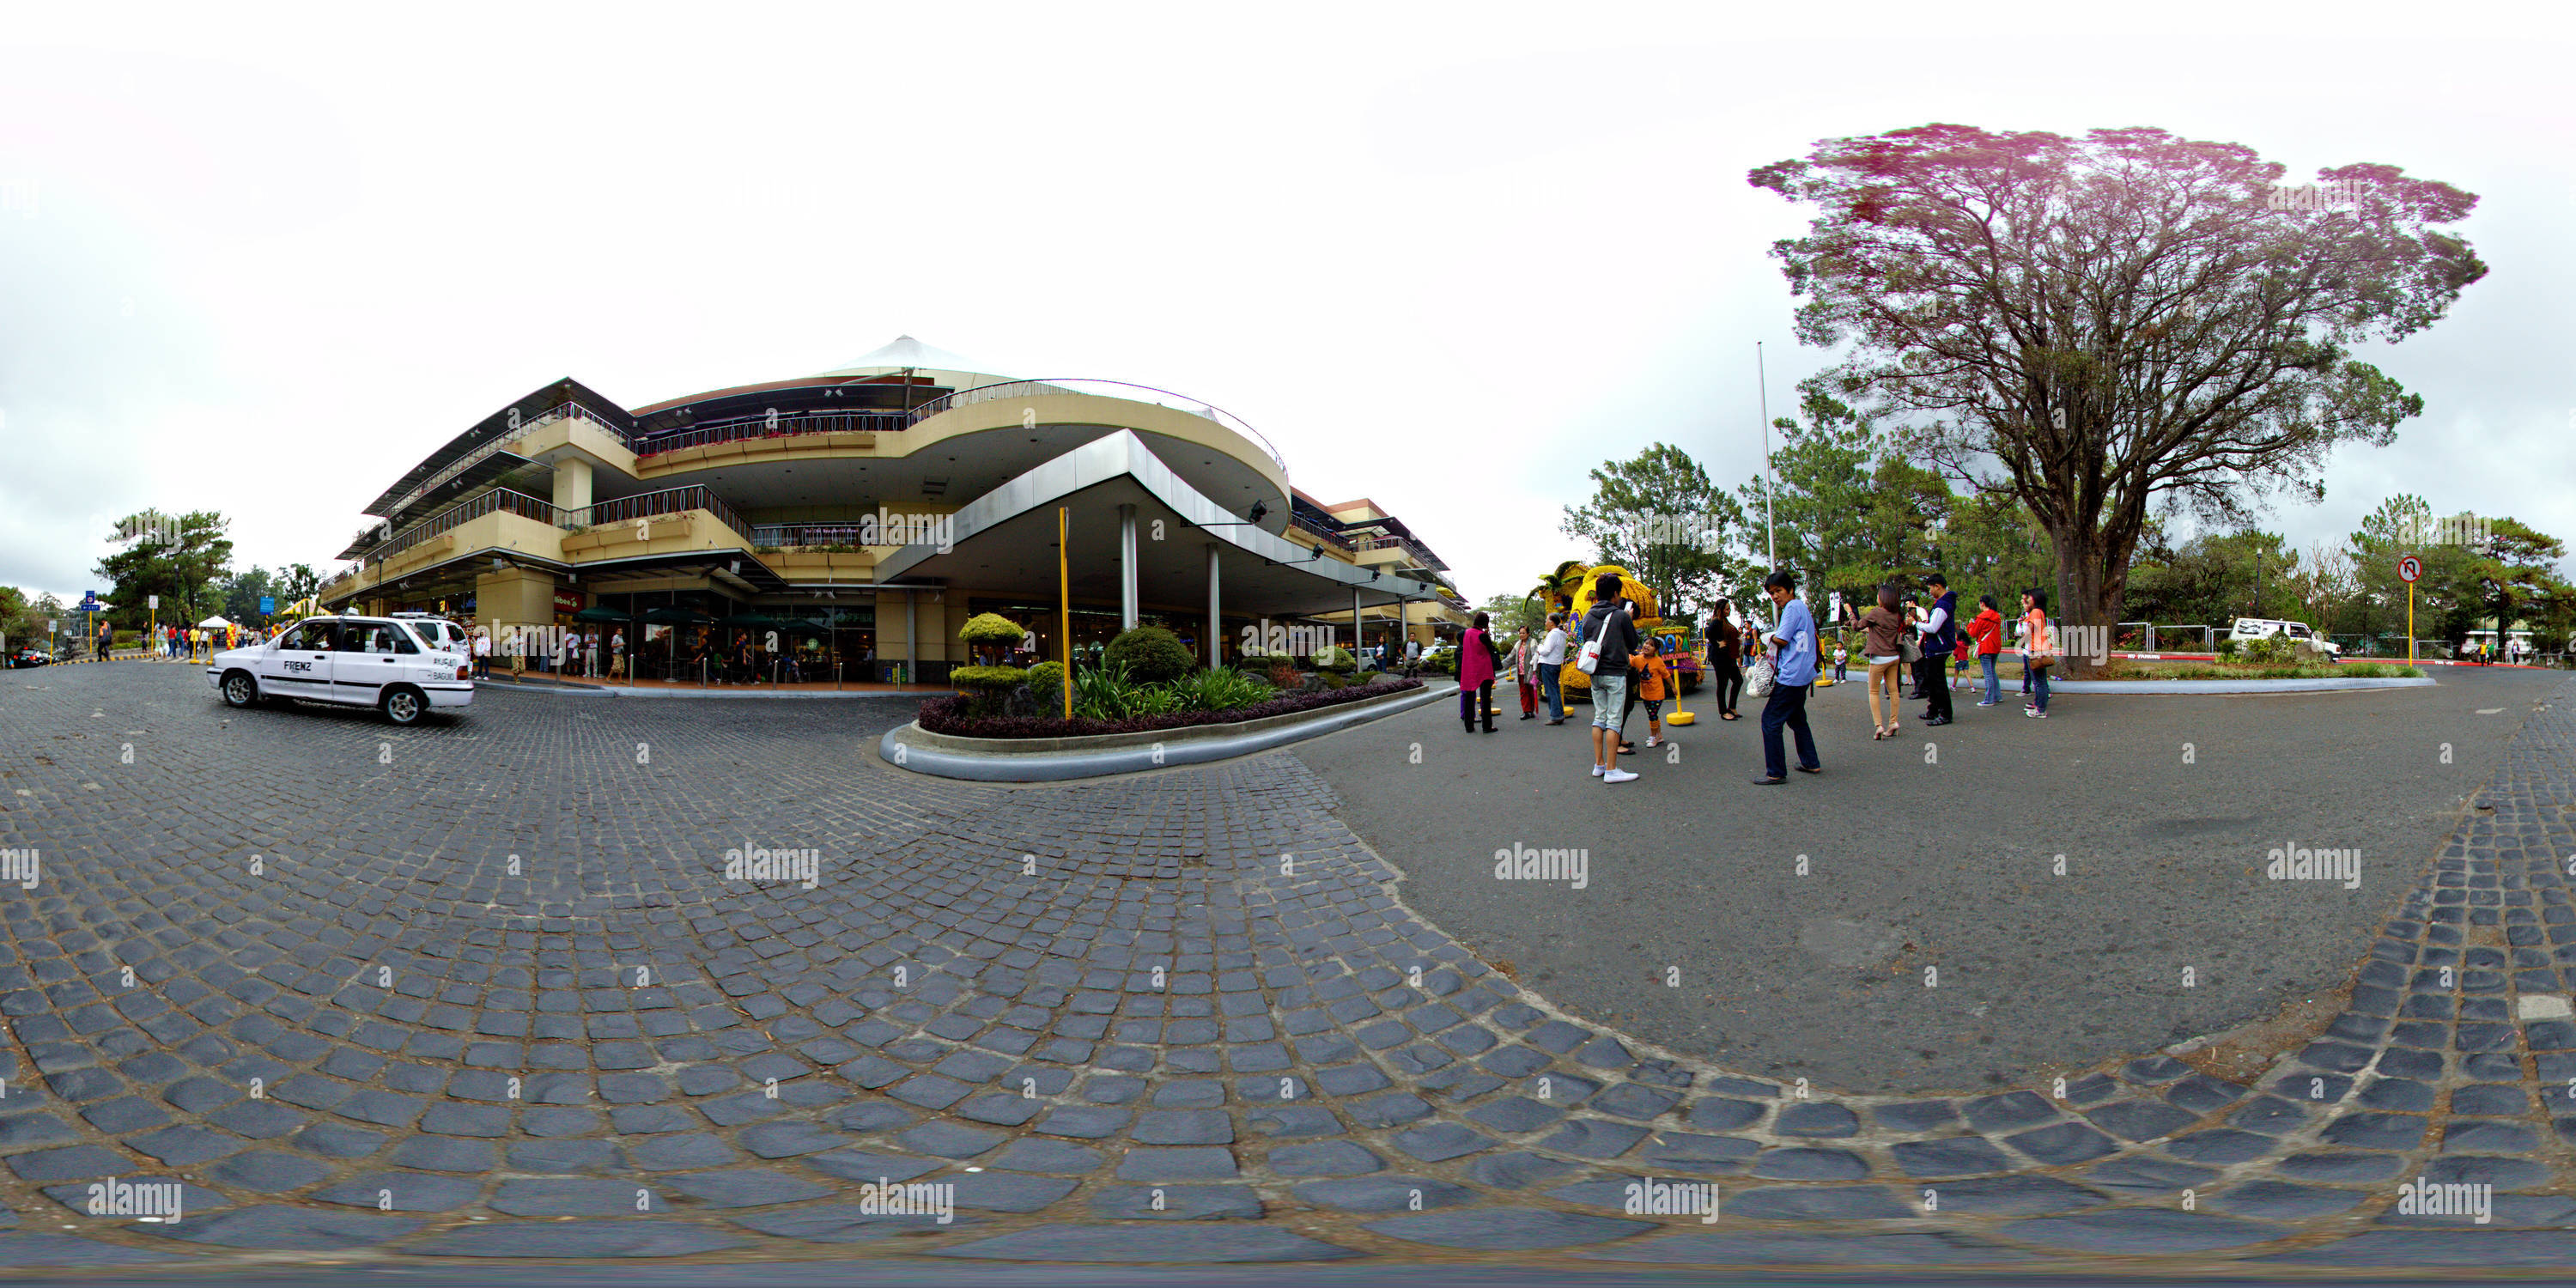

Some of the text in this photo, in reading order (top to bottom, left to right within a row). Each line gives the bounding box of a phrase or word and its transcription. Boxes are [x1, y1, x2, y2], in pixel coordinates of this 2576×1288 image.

[554, 595, 571, 605] llibee
[1656, 634, 1690, 655] DORA
[284, 661, 312, 671] FRENZ
